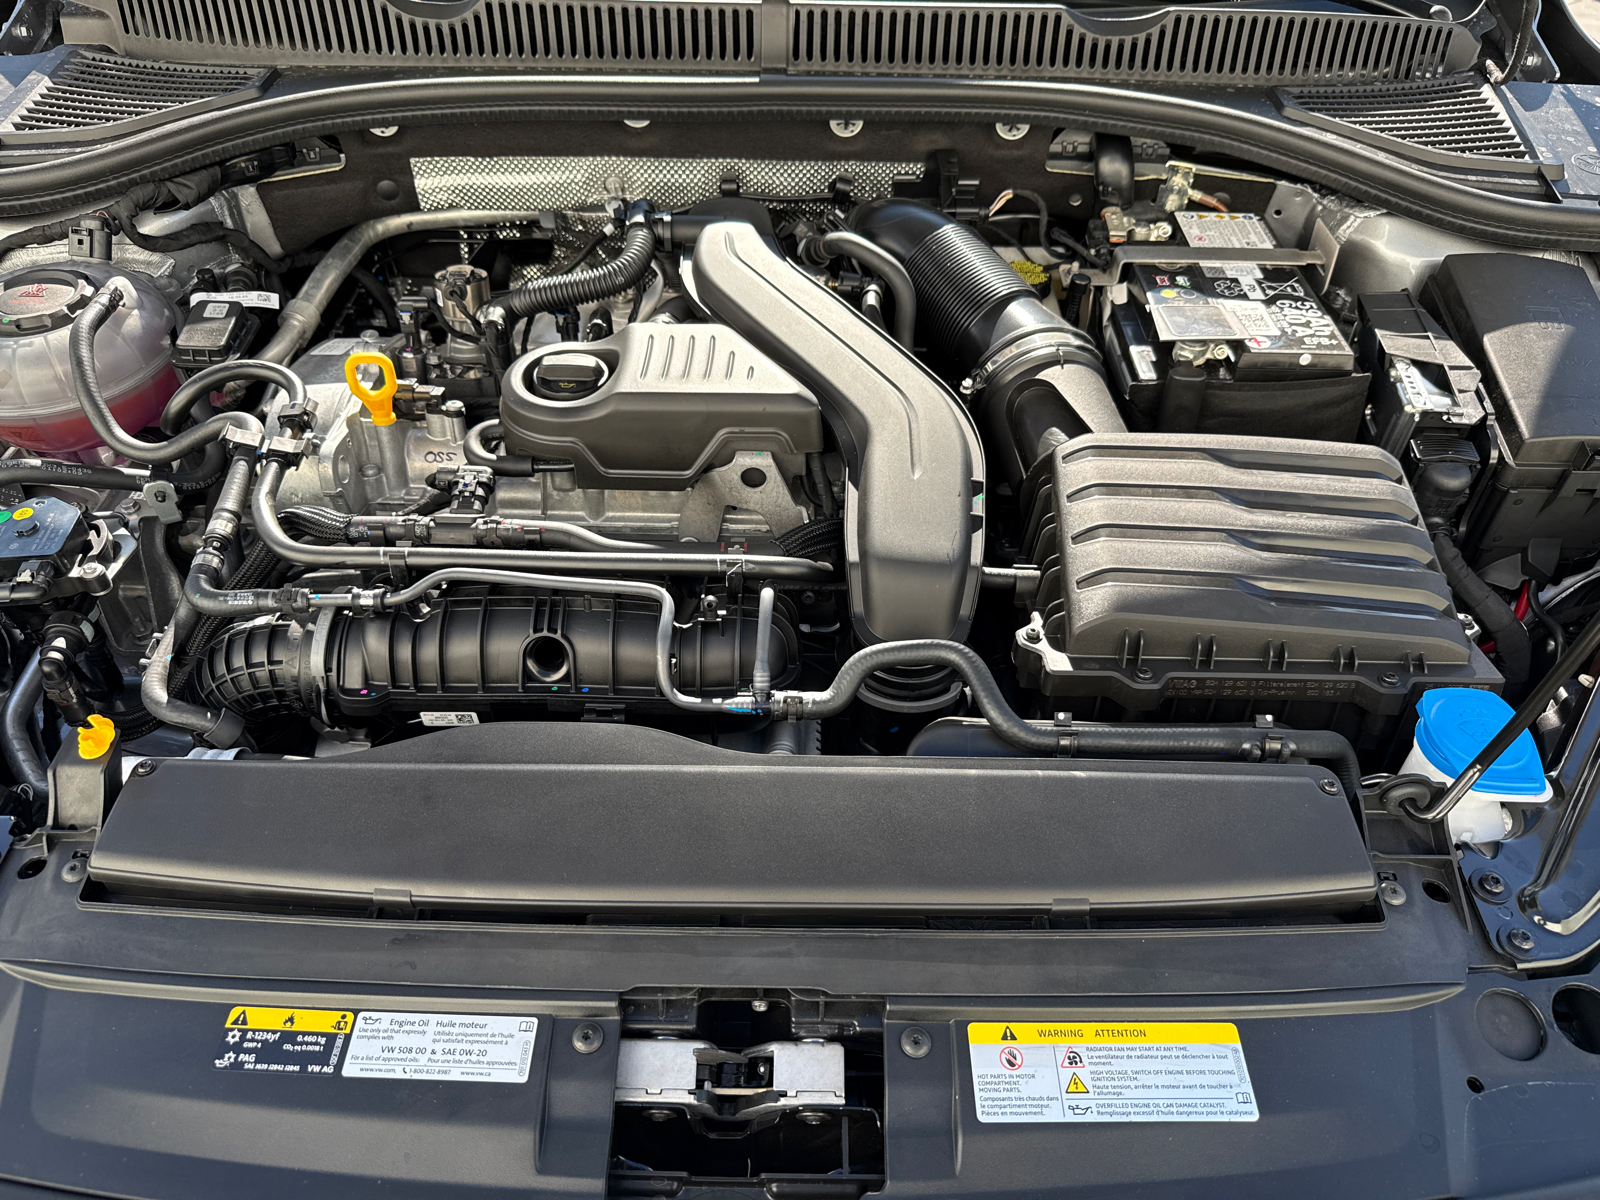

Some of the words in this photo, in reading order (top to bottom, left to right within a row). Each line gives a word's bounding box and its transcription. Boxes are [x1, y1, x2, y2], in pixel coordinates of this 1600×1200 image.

[1276, 300, 1307, 324] 640
[1297, 302, 1333, 335] 59Ah
[390, 1019, 416, 1028] Engine
[246, 1032, 280, 1042] R-1234yf
[1095, 1029, 1146, 1038] ATTENTION
[238, 1054, 256, 1062] PAG
